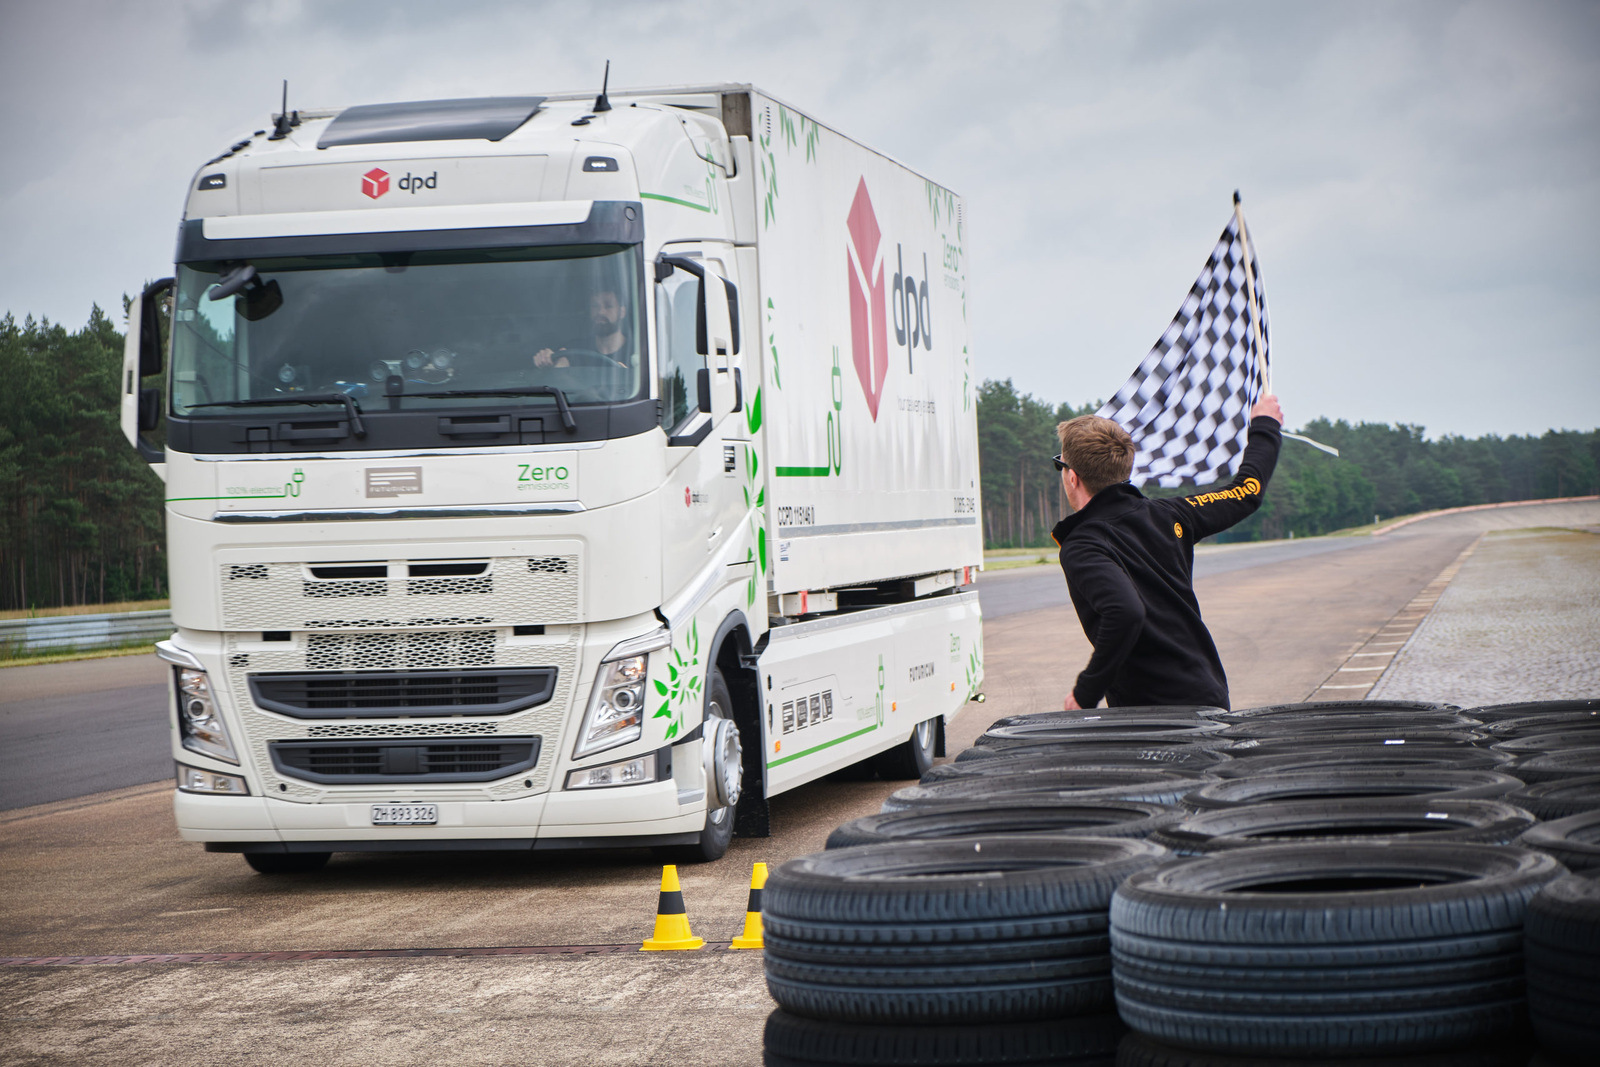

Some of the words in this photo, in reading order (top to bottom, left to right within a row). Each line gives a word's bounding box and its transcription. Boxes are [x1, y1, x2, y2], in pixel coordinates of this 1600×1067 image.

[398, 171, 437, 194] dpd
[893, 242, 932, 375] dpd
[517, 464, 569, 481] Zero
[517, 482, 569, 491] emissions
[1194, 477, 1261, 507] Continental
